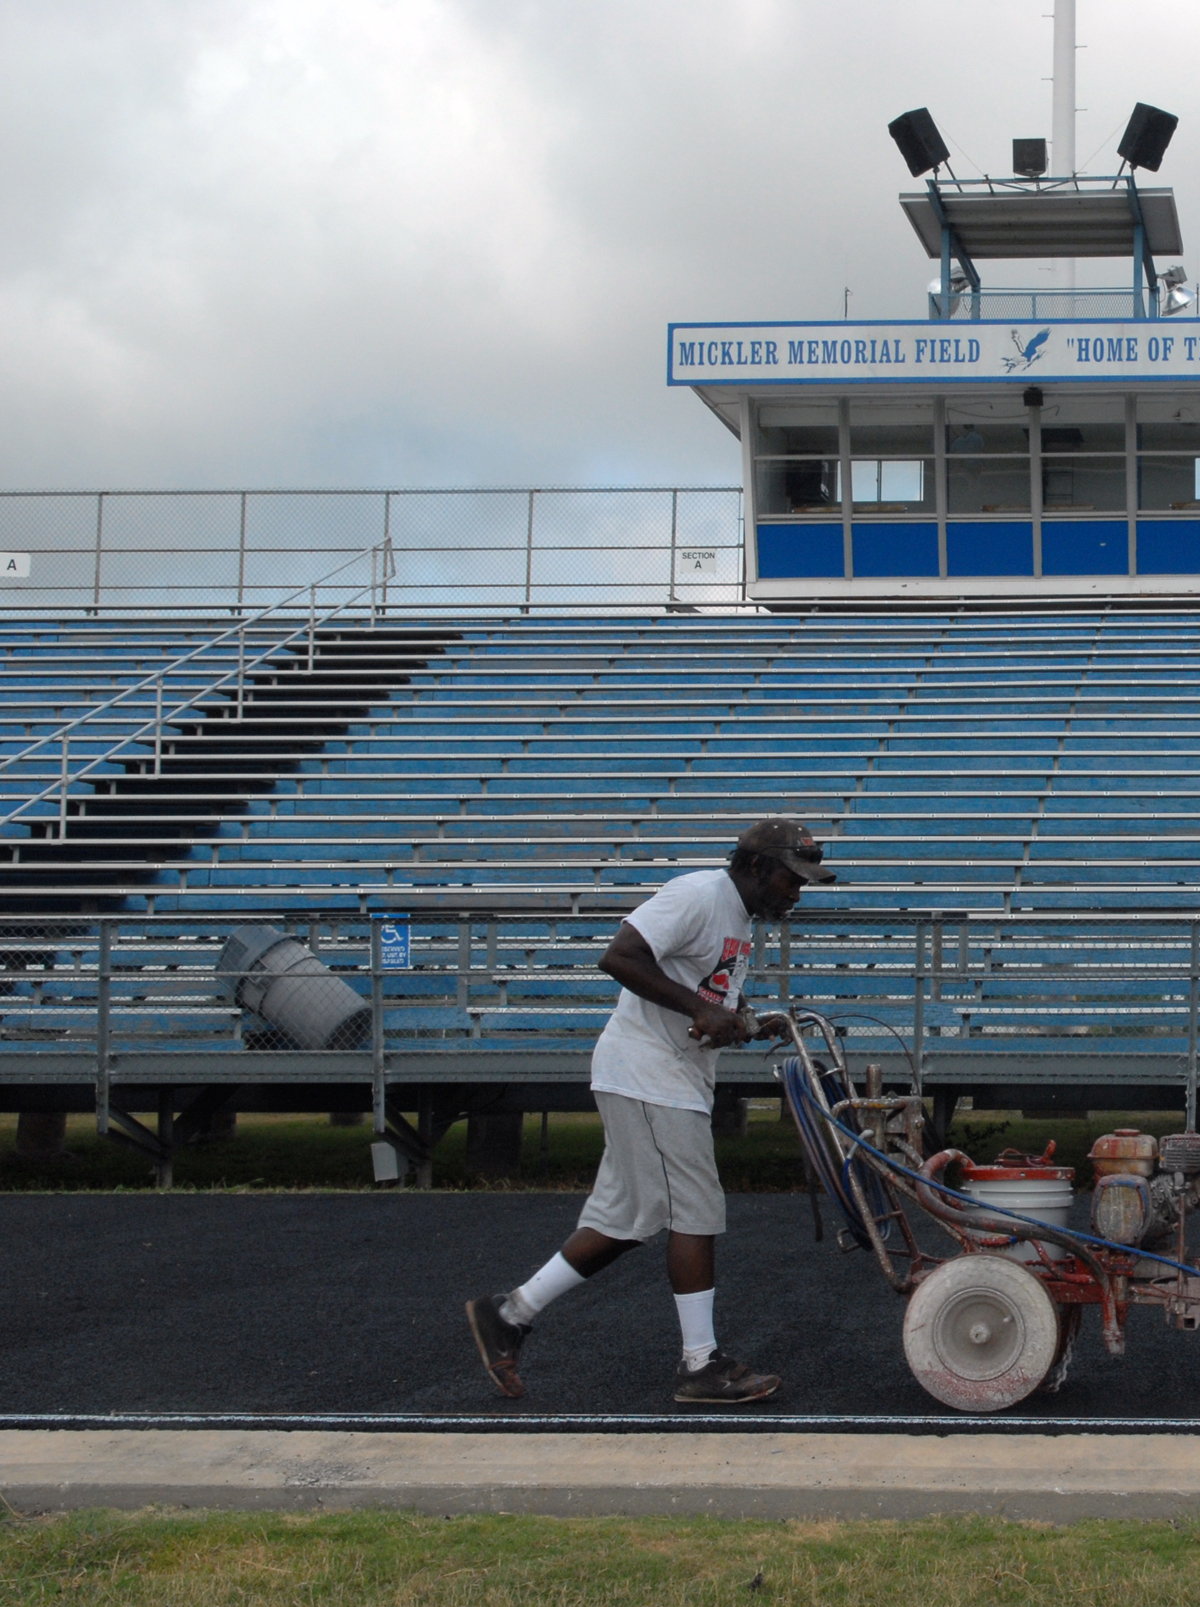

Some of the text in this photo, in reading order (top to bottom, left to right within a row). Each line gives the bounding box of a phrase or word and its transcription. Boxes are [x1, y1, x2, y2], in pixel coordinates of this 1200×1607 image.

[678, 338, 981, 366] MICKLER MEMORIAL FIELD
[1067, 337, 1139, 363] "HOME
[1147, 337, 1174, 362] OF
[682, 551, 715, 559] SECTION
[6, 558, 17, 571] A
[694, 560, 702, 569] A
